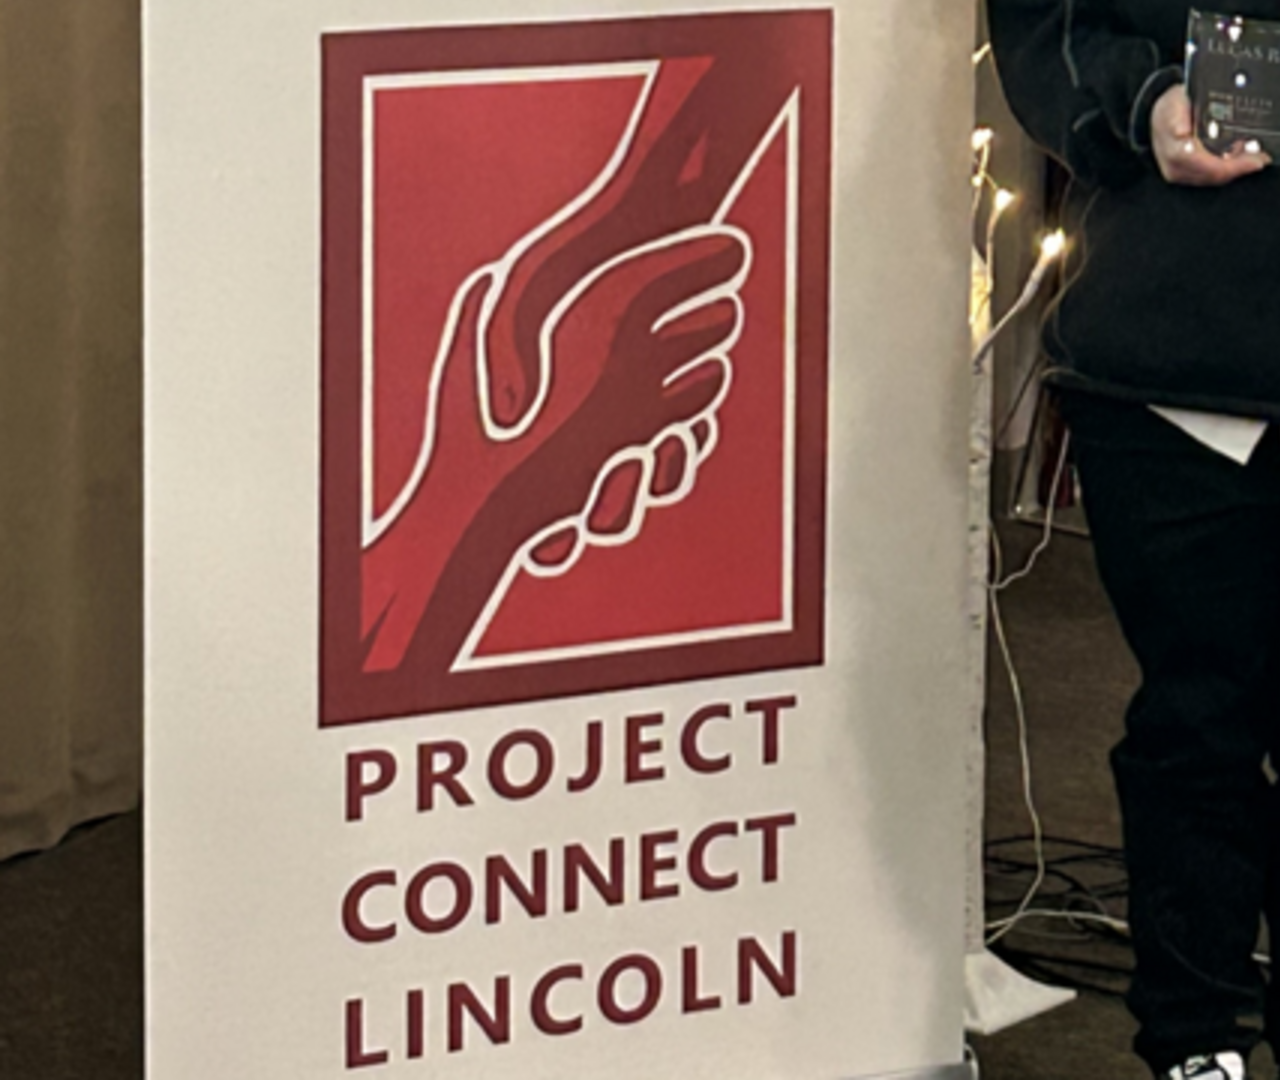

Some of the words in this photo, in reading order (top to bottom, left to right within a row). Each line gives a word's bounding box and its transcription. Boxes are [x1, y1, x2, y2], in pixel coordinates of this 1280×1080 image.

[1207, 38, 1263, 60] LUCAS
[344, 695, 797, 822] PROJECT
[341, 812, 797, 943] CONNECT
[344, 930, 797, 1069] LINCOLN
